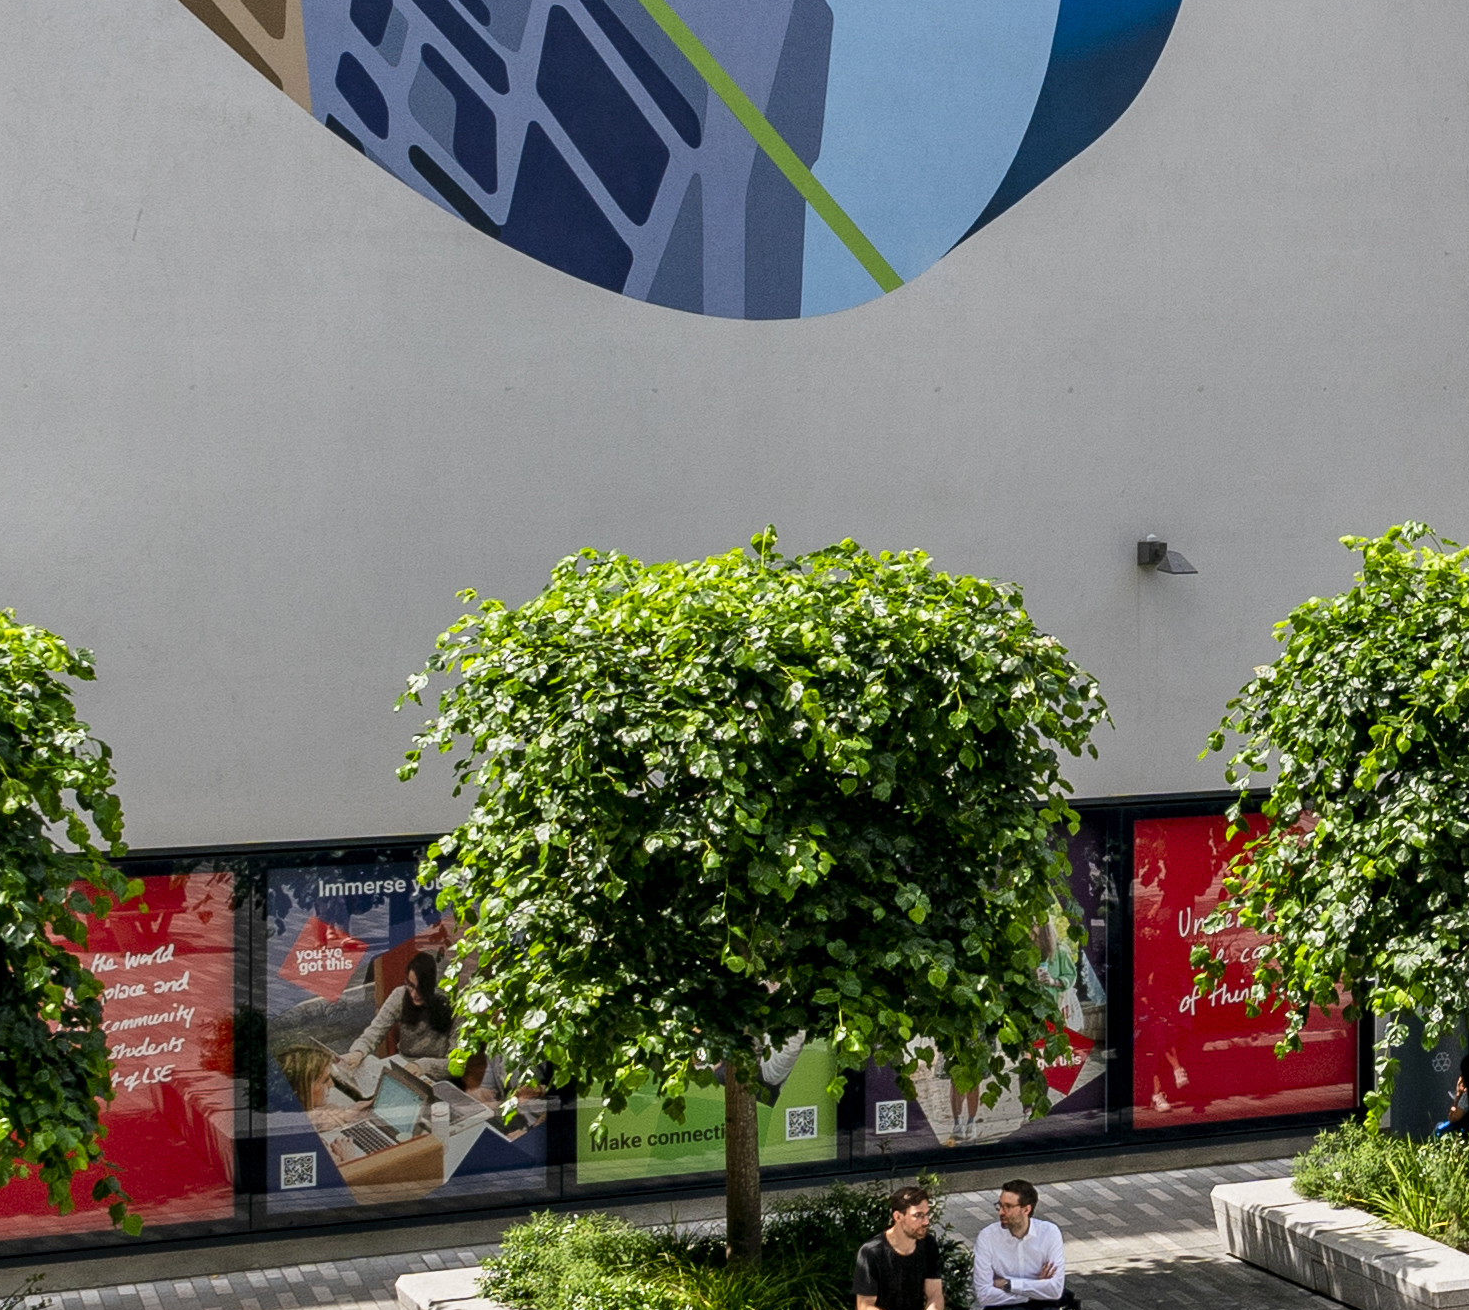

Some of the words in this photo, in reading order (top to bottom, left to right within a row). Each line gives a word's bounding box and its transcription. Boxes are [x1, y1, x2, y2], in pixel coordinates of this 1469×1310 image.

[318, 878, 406, 898] Immerse
[91, 953, 118, 973] the
[295, 946, 343, 964] you've
[299, 960, 323, 976] got
[324, 958, 353, 972] this
[101, 982, 147, 1006] place
[153, 971, 190, 994] and
[1179, 985, 1202, 1016] of
[142, 1064, 176, 1084] LSE
[591, 1133, 642, 1152] Make
[648, 1123, 726, 1147] connecti
